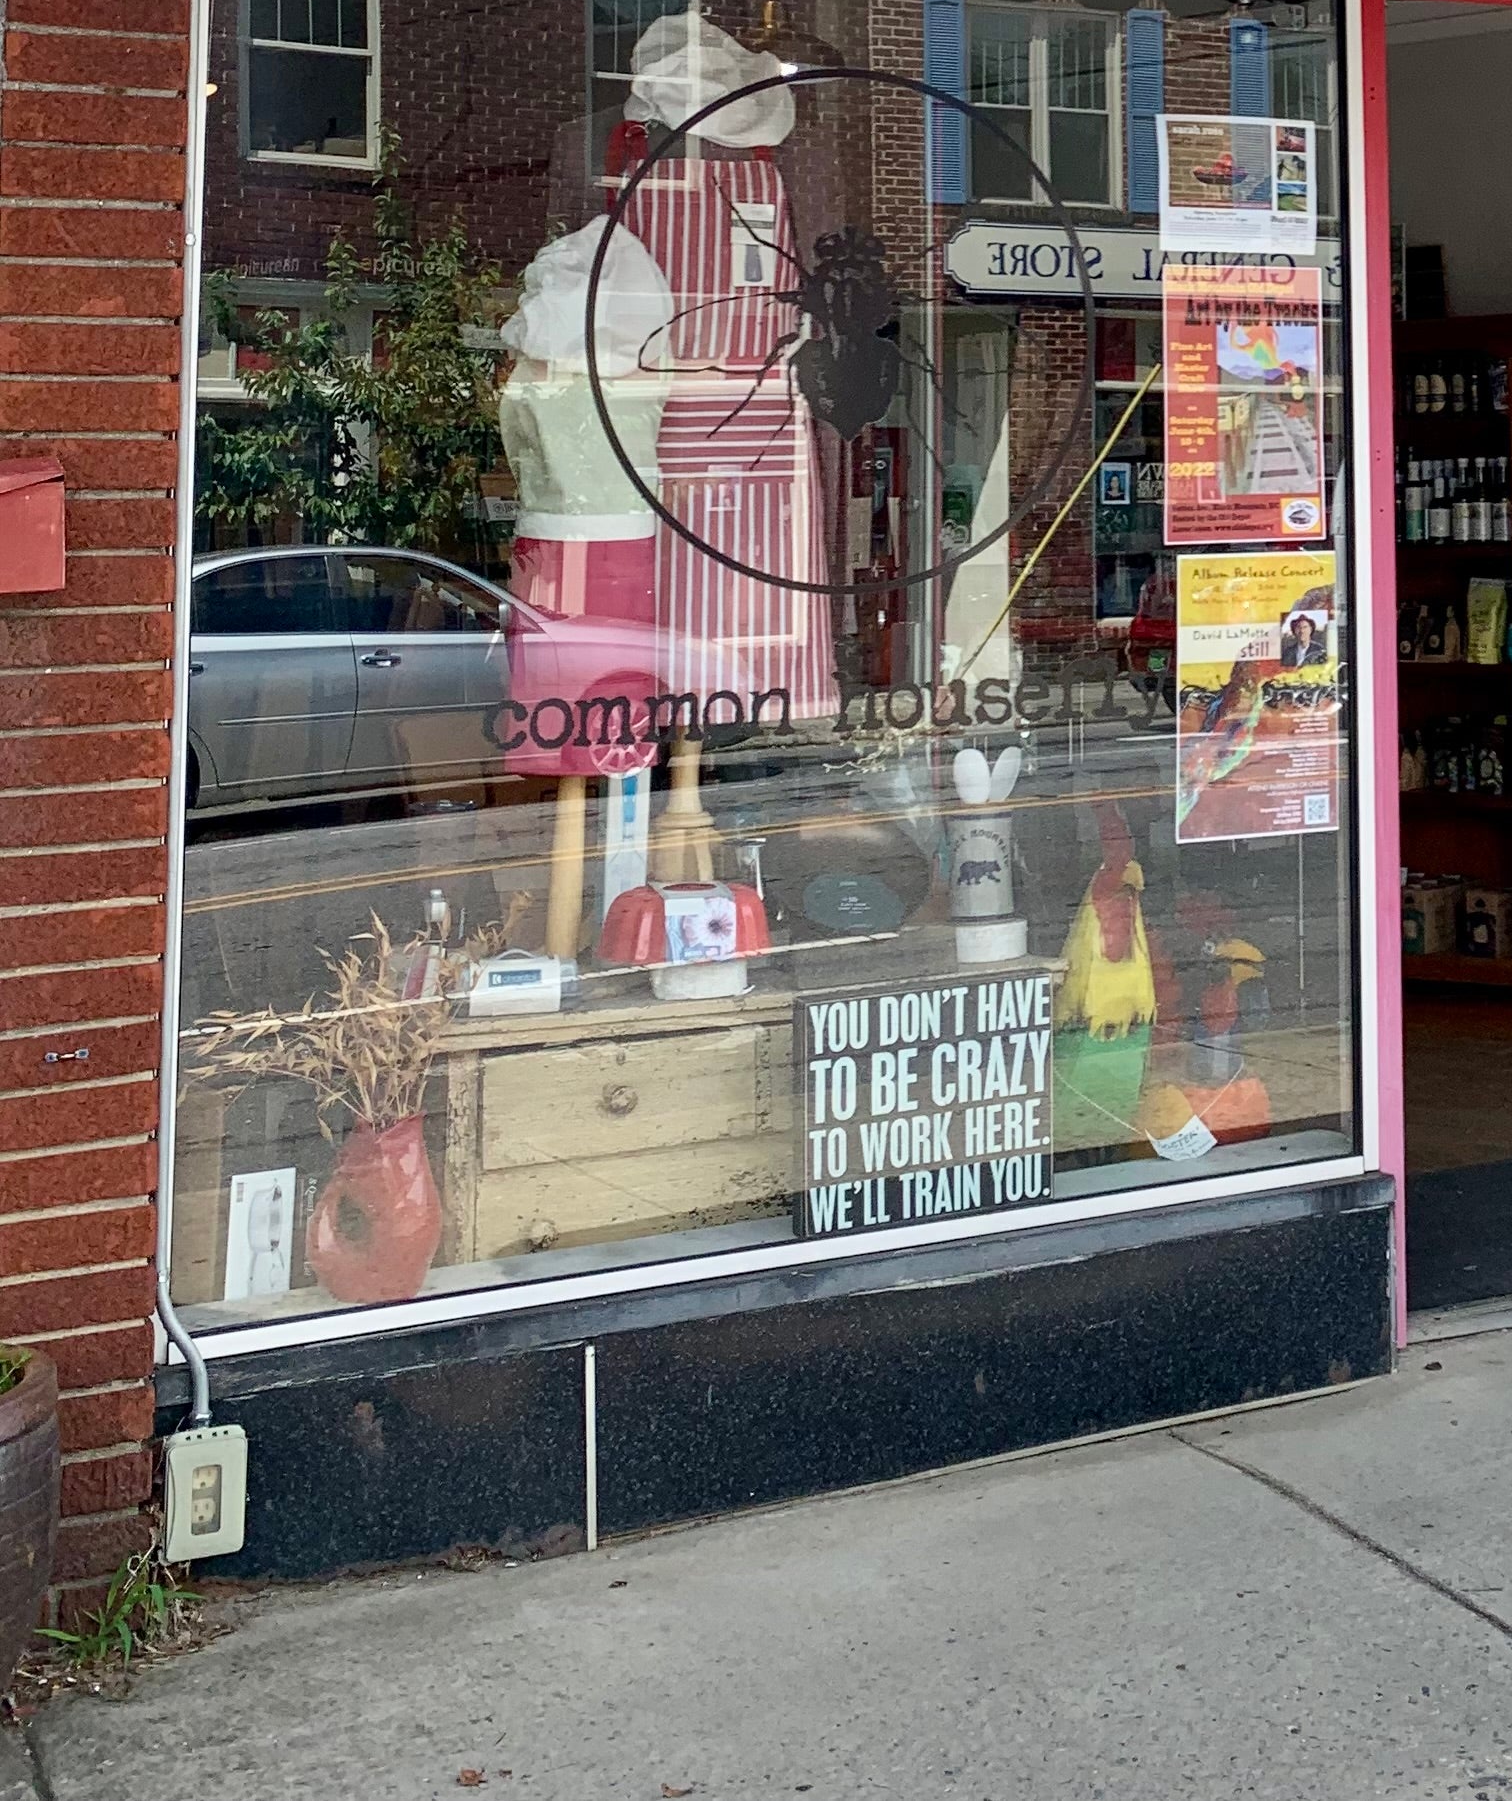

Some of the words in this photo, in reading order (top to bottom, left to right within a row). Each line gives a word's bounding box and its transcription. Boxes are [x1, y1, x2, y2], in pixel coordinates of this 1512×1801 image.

[1169, 462, 1217, 477] 2022
[1192, 569, 1230, 579] Album
[1234, 566, 1276, 578] Release
[1281, 565, 1325, 578] Concert
[1193, 630, 1222, 641] David
[1240, 642, 1270, 658] still
[482, 685, 796, 750] common
[831, 659, 1172, 731] housefly
[809, 999, 870, 1056] YOU
[879, 986, 969, 1047] DON'T
[977, 976, 1051, 1033] HAVE
[809, 1056, 857, 1124] TO
[871, 1048, 919, 1116] BE
[931, 1029, 1051, 1107] CRAZY
[809, 1127, 848, 1181] TO
[859, 1111, 953, 1173] WORK
[964, 1098, 1051, 1158] HERE.
[809, 1175, 891, 1235] WE'LL
[899, 1161, 981, 1221] TRAIN
[989, 1152, 1051, 1205] YOU.
